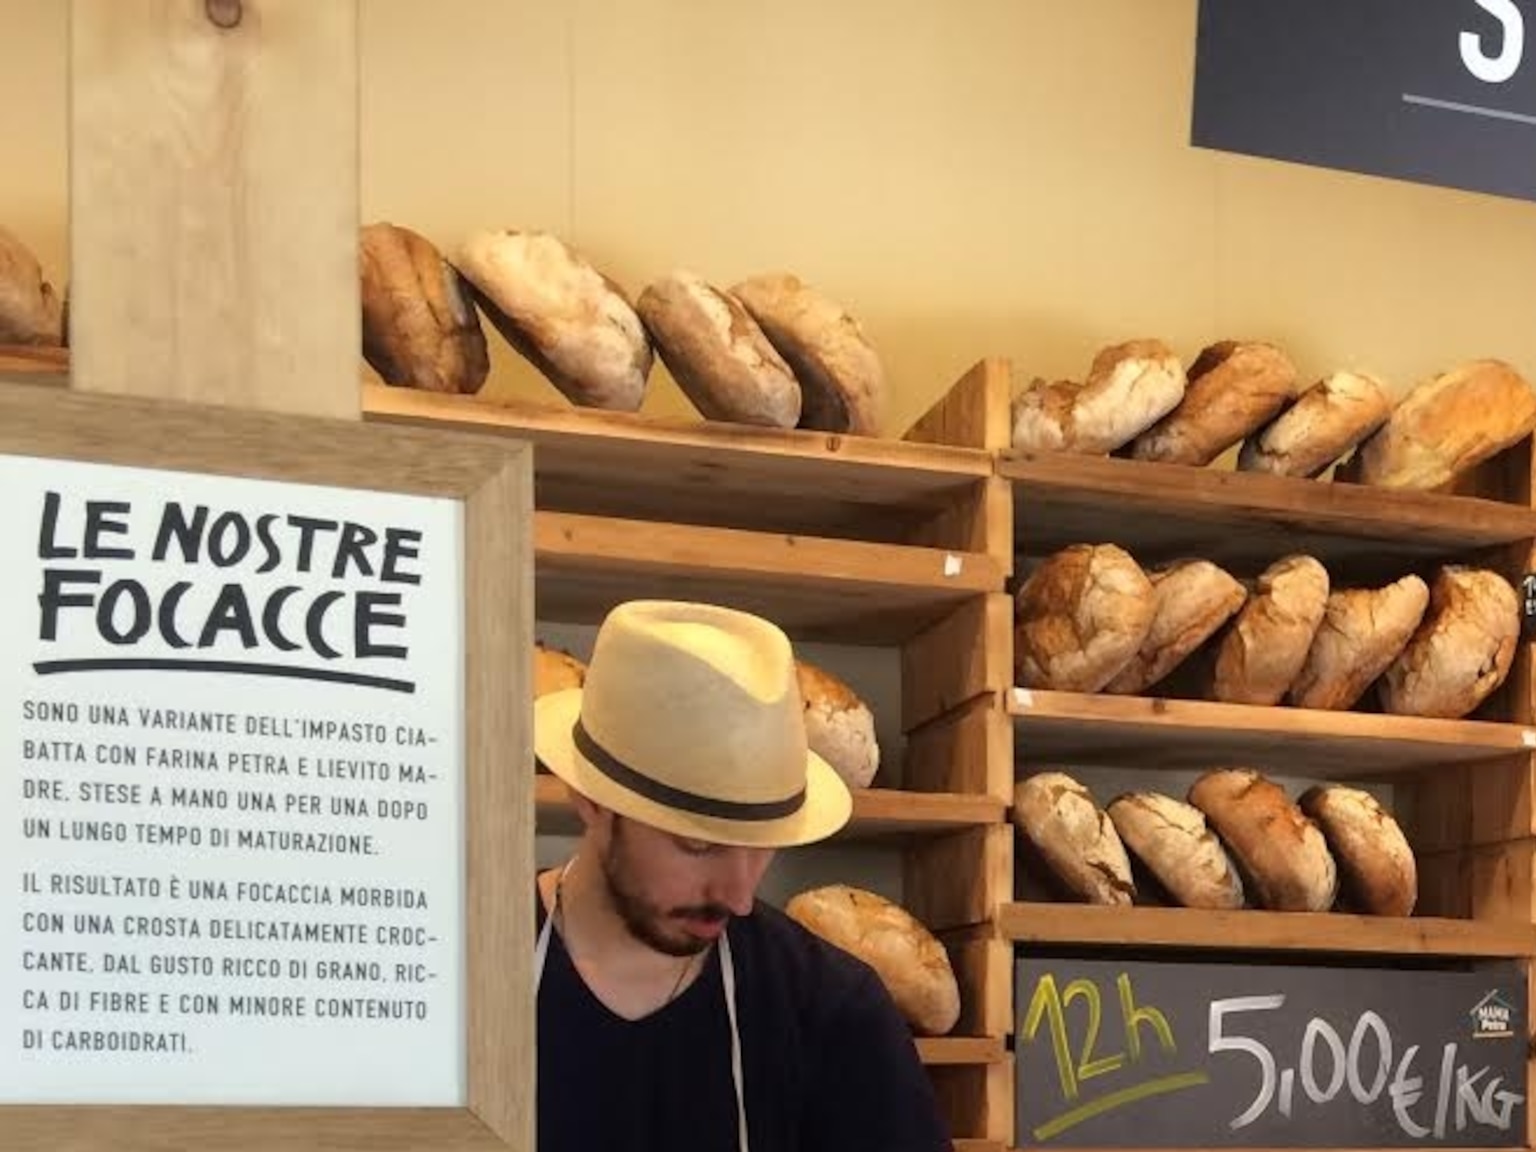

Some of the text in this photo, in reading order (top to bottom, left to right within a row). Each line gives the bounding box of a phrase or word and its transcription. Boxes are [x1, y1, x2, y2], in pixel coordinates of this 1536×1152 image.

[39, 492, 422, 585] LE NOSTRE
[39, 568, 411, 659] FOCACCE
[23, 700, 436, 746] SONO UNA VARIANTE DELL'IMPASTO CIA-
[23, 740, 436, 783] BATTA CON FARINA PETRA E LIEVITO MA-
[79, 782, 140, 804] STESE
[151, 787, 161, 805] A
[172, 788, 227, 809] MANO
[238, 792, 276, 812] UNA
[286, 794, 321, 814] PER
[331, 797, 368, 816] UNA
[378, 799, 427, 820] DOPO
[24, 819, 378, 855] UN LUNGO TEMPO DI MATURAZIONE.
[23, 873, 427, 909] IL RISULTATO È UNA FOCACCIA MORBIDA
[23, 912, 437, 946] CON UNA CROSTA DELICATAMENTE CROC-
[104, 954, 141, 974] DAL
[150, 955, 213, 976] GUSTO
[222, 957, 280, 978] RICCO
[289, 960, 307, 979] DI
[395, 964, 436, 983] RIC-
[23, 990, 426, 1020] CA DI FIBRE E CON MINORE CONTENUTO
[23, 1029, 42, 1049] DI
[1021, 972, 1177, 1099] 12h
